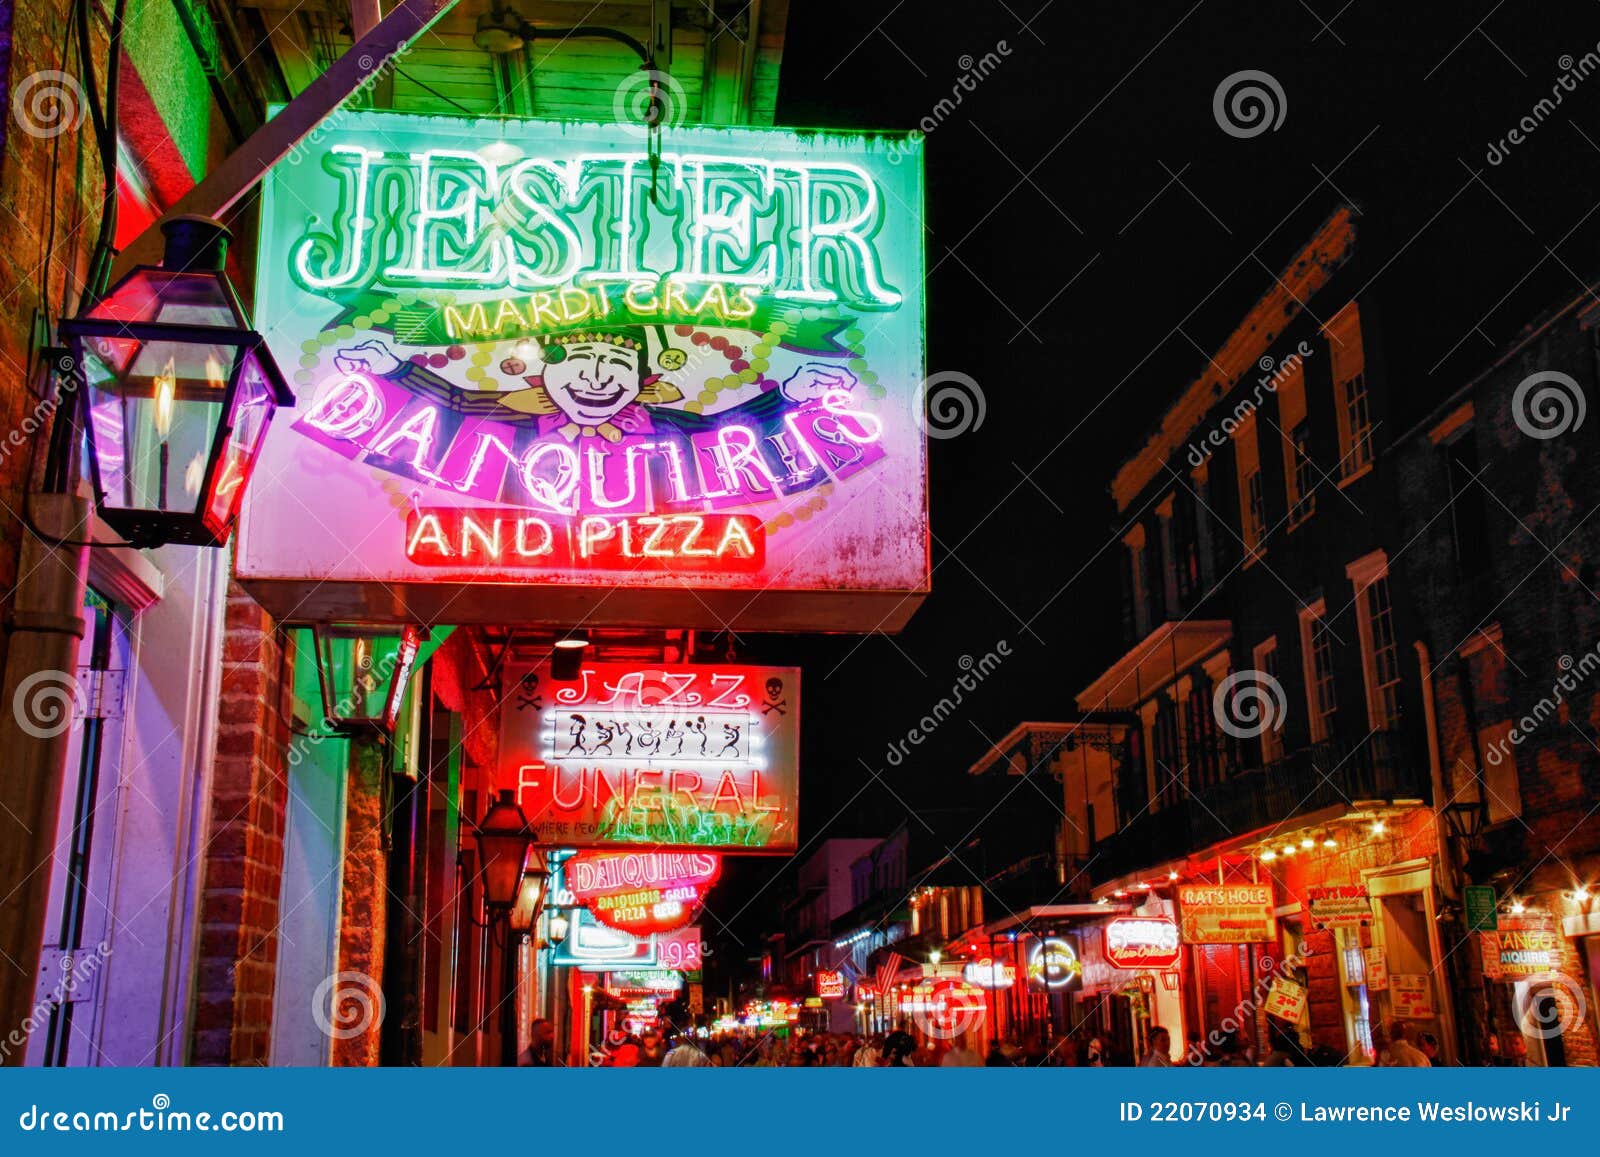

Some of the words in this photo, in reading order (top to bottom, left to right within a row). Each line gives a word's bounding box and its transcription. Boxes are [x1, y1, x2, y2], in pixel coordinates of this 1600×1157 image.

[289, 144, 903, 309] JESTER
[443, 284, 608, 338] MARDI
[621, 280, 762, 321] GRAS
[301, 370, 885, 515] DAIQUIRIS
[406, 515, 552, 558] AND
[578, 514, 756, 557] PIZZA
[556, 670, 750, 708] JAZZ
[517, 764, 782, 814] FUNERAL
[575, 853, 716, 893] DAIQUIRIS
[598, 889, 661, 909] DAIQUIRIS
[613, 906, 647, 923] PIZZA
[1185, 888, 1225, 905] RAT'S
[1227, 888, 1267, 905] HOLE
